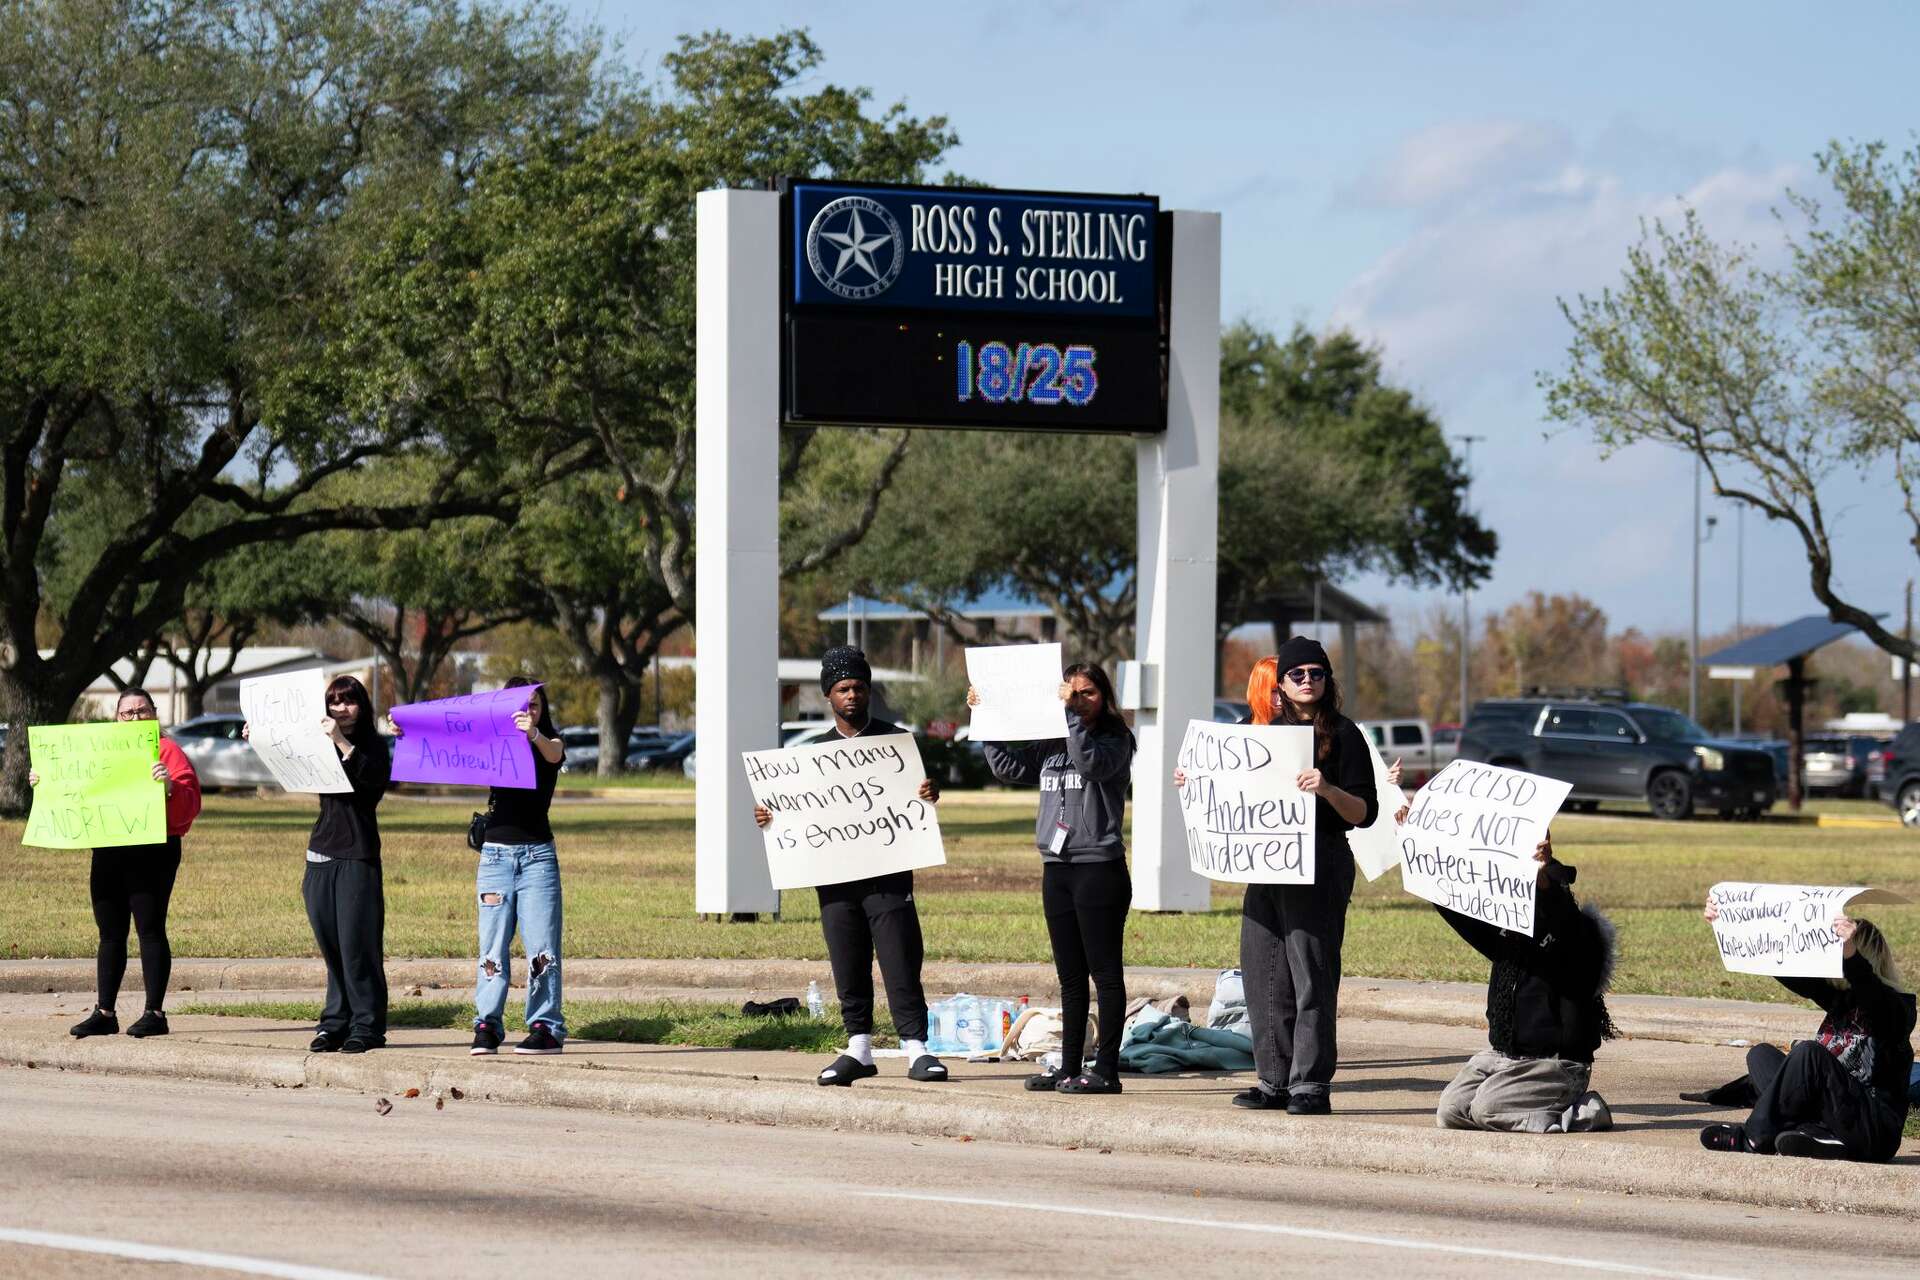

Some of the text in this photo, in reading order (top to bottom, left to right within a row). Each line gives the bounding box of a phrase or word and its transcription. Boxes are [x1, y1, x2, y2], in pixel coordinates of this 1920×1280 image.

[910, 204, 1147, 262] ROSS S. STERLING
[825, 278, 890, 298] RANGERS
[935, 264, 1123, 303] HIGH SCHOOL
[444, 711, 473, 734] For
[747, 756, 800, 781] How
[1181, 726, 1272, 772] GCCISD
[1427, 762, 1538, 807] GCCISD
[33, 802, 151, 840] ANDREW
[1203, 779, 1307, 834] Andrew
[1407, 796, 1535, 846] does NOT
[777, 829, 797, 850] is
[1402, 837, 1536, 900] Protect their
